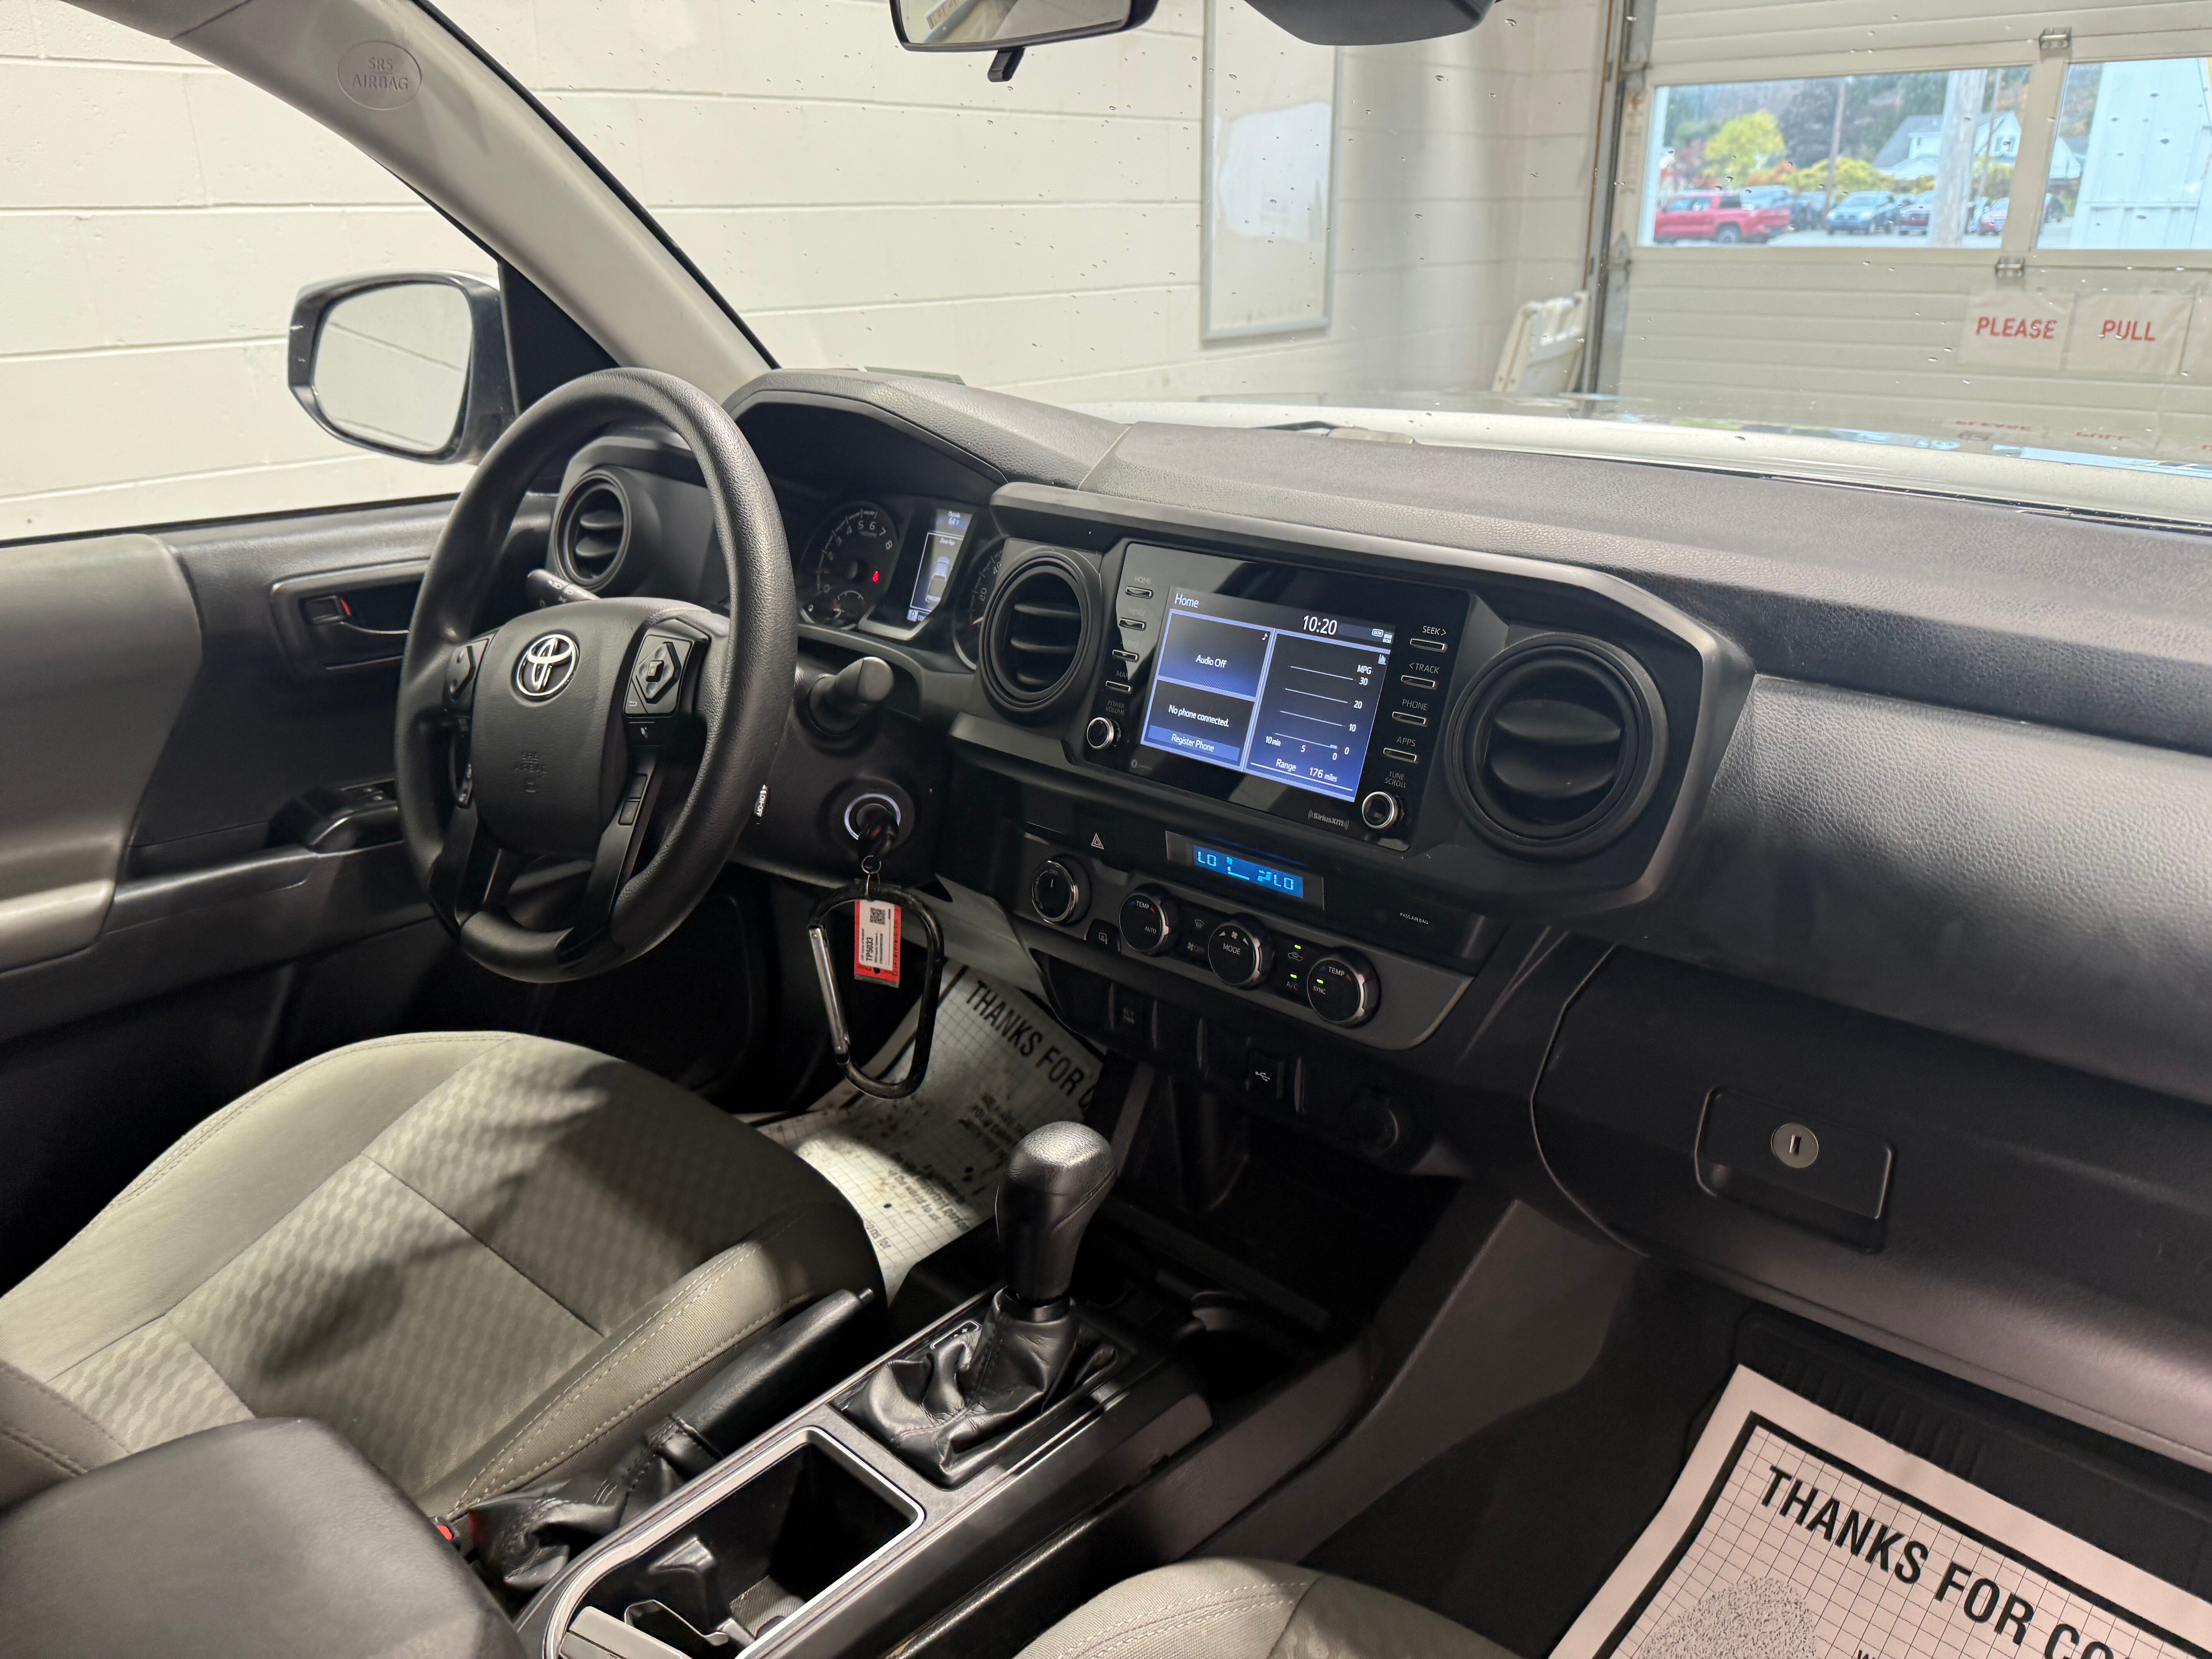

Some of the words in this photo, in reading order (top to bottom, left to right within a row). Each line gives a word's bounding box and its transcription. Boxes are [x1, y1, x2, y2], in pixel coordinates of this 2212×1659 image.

[368, 58, 393, 70] SRS
[353, 74, 408, 90] AIRBAG
[1976, 316, 2057, 339] PLEASE
[2101, 319, 2155, 341] PULL
[858, 520, 864, 529] 5
[869, 522, 876, 530] 6
[879, 527, 886, 536] 7
[886, 540, 893, 550] 8
[1134, 576, 1151, 585] HOME
[979, 587, 987, 601] 20
[1175, 593, 1199, 608] Home
[1128, 607, 1145, 617] MENU
[1303, 615, 1338, 635] 10:20
[1422, 625, 1440, 636] SEEK
[1196, 654, 1214, 666] Audio
[1214, 658, 1227, 668] Off
[1357, 665, 1372, 675] MPG
[1359, 677, 1369, 686] 30
[1108, 700, 1125, 709] POWER
[1353, 700, 1363, 709] 20
[1402, 699, 1428, 711] PHONE
[1106, 706, 1125, 715] VOLUME
[1168, 704, 1178, 714] No
[1178, 708, 1197, 719] phone
[1197, 714, 1230, 727] connected.
[1349, 723, 1356, 732] 10
[1171, 733, 1195, 747] Register
[1195, 739, 1214, 752] Phone
[1266, 736, 1273, 744] 10
[1272, 738, 1281, 747] min
[1396, 736, 1416, 747] APPS
[1344, 747, 1350, 755] 0
[1332, 752, 1338, 761] 0
[1276, 758, 1297, 772] Range
[1309, 767, 1323, 778] 176
[1324, 773, 1338, 782] miles
[1389, 771, 1405, 780] TUNE
[1385, 778, 1407, 788] SCROLL
[1197, 851, 1216, 867] LO
[1274, 874, 1293, 890] LO
[1135, 900, 1150, 909] TEMP
[1145, 926, 1157, 934] AUTO
[1223, 943, 1241, 955] MODE
[1328, 966, 1345, 977] TEMP
[1286, 981, 1298, 990] A/C
[1312, 986, 1326, 995] SYNC
[966, 980, 1043, 1057] THANKS
[1036, 1046, 1084, 1096] FOR
[1761, 1465, 1929, 1585] THANKS
[1934, 1561, 2034, 1645] FOR
